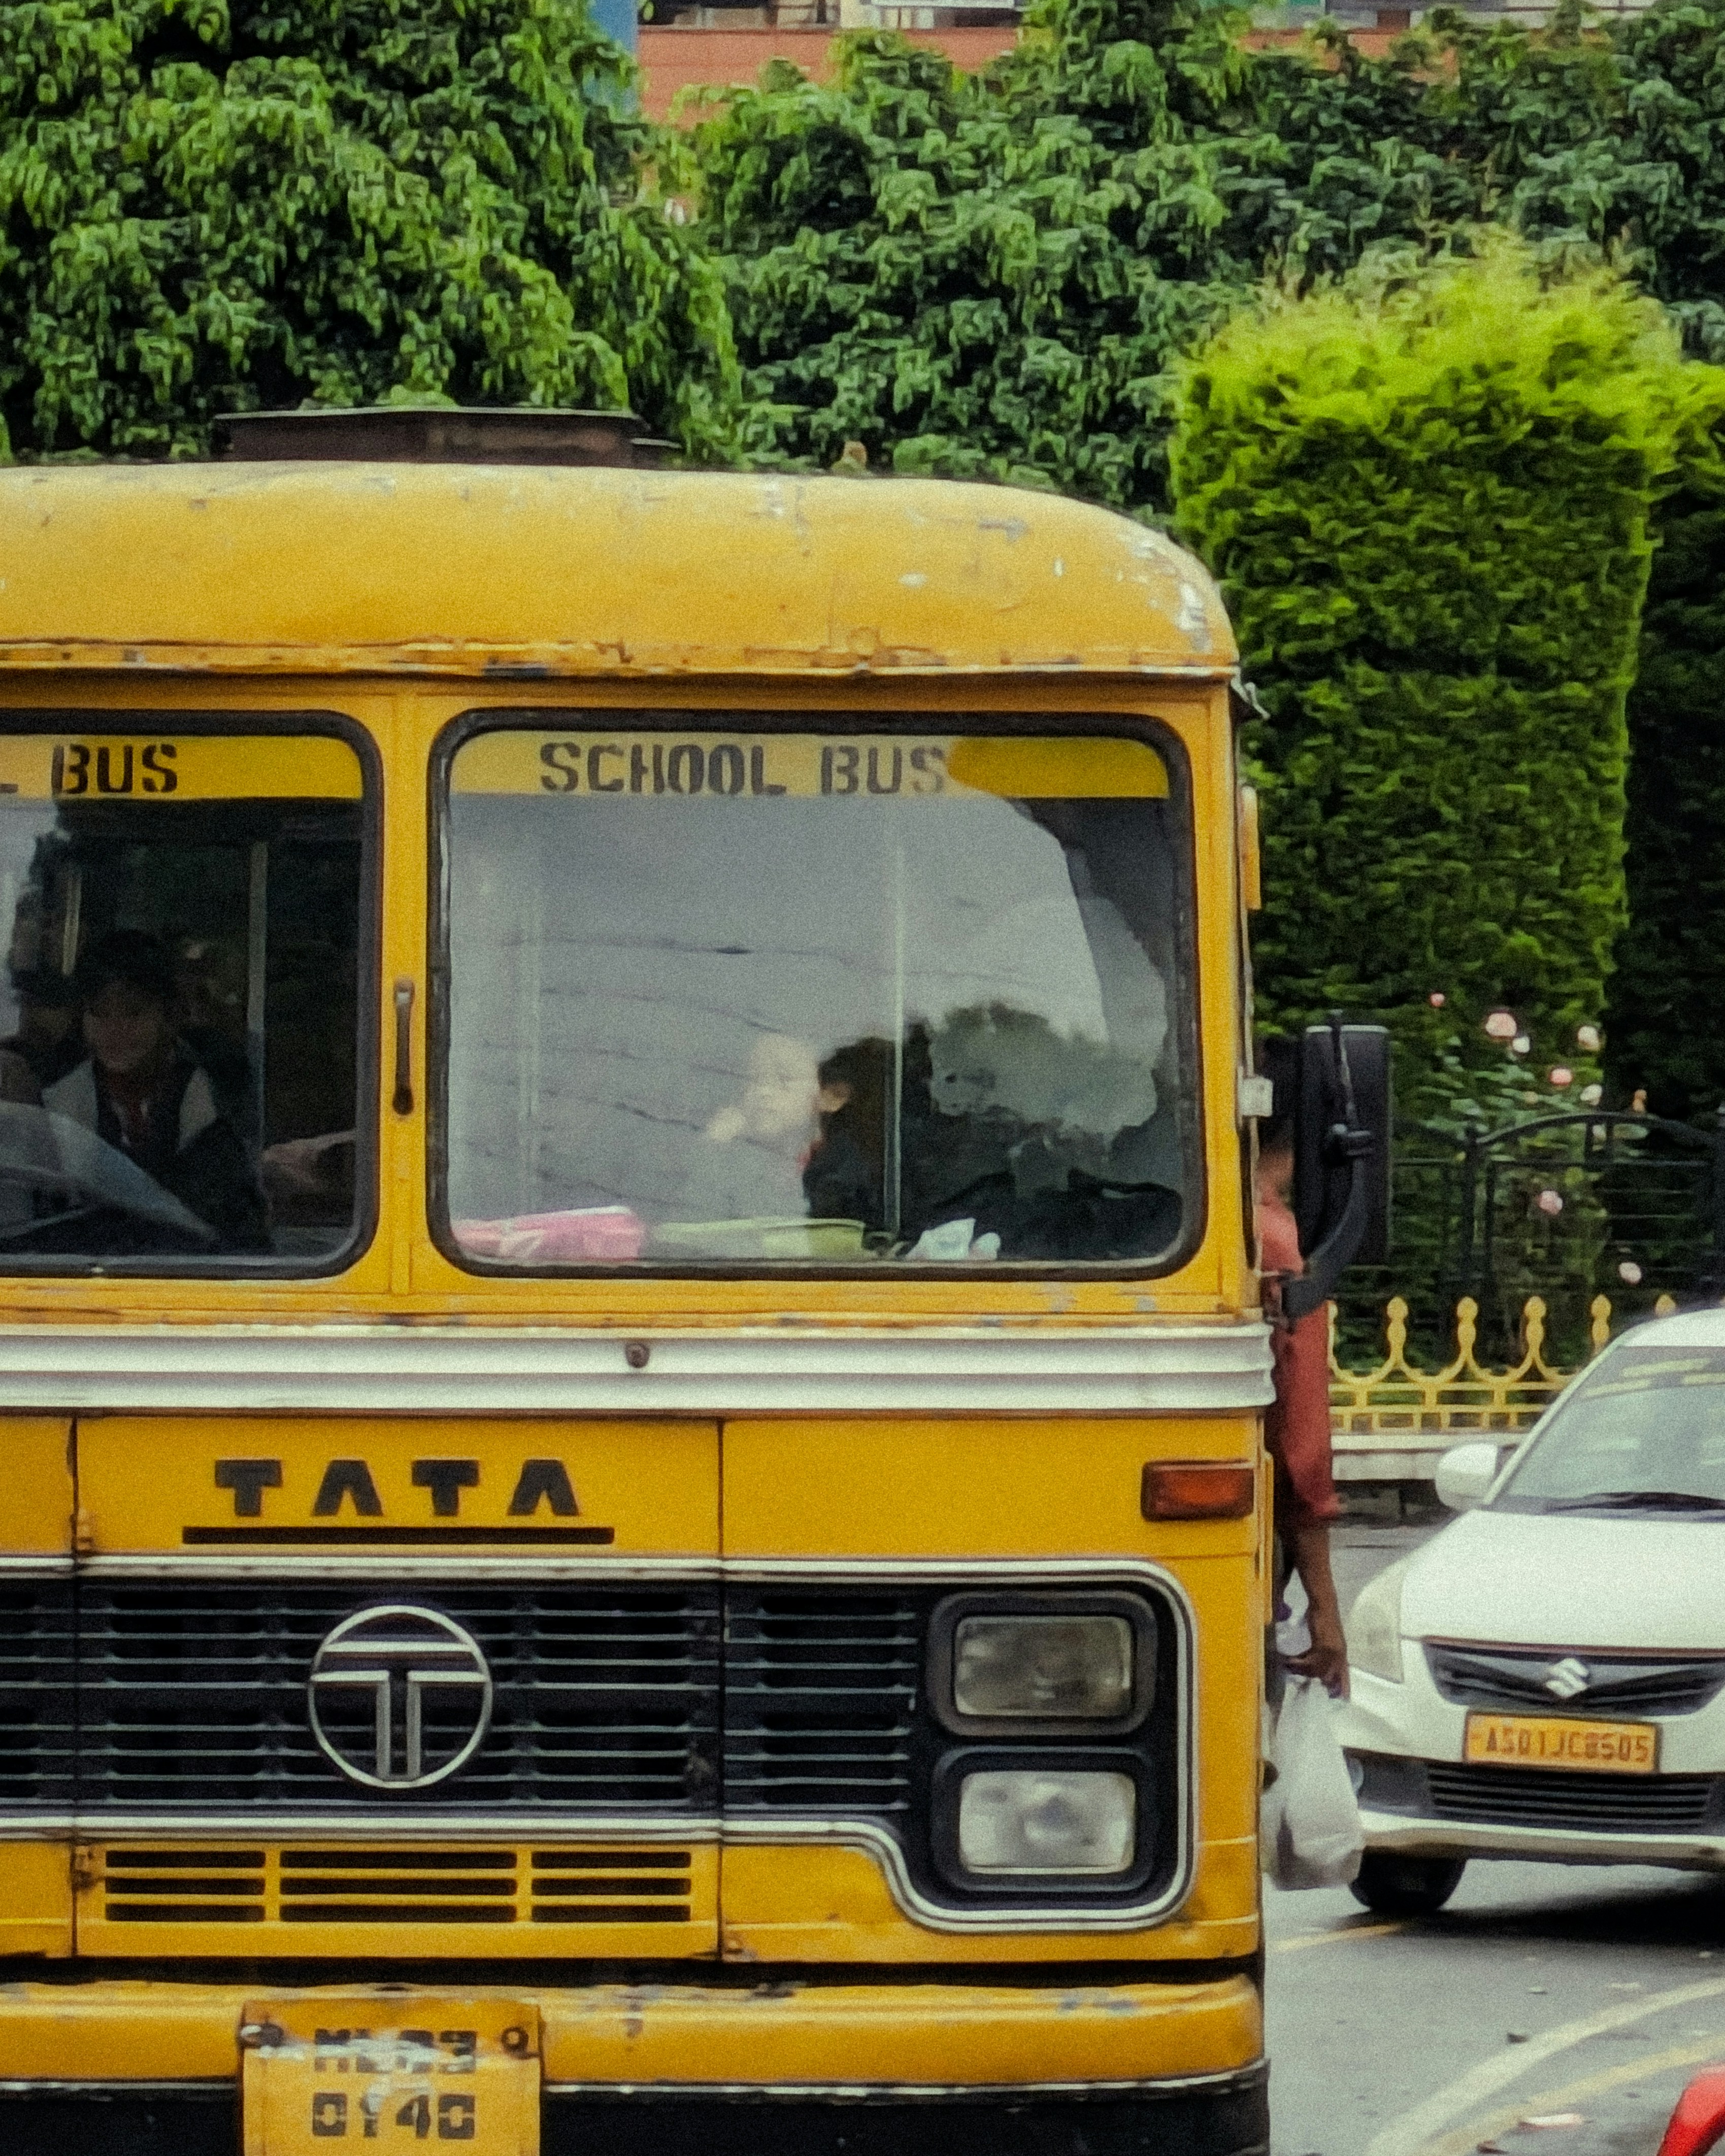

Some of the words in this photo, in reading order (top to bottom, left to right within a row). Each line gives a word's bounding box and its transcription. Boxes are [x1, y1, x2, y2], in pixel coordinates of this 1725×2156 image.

[52, 744, 177, 794] BUS
[540, 742, 786, 794] SCHOOL
[821, 745, 944, 794] BUS
[214, 1459, 580, 1517] TATA
